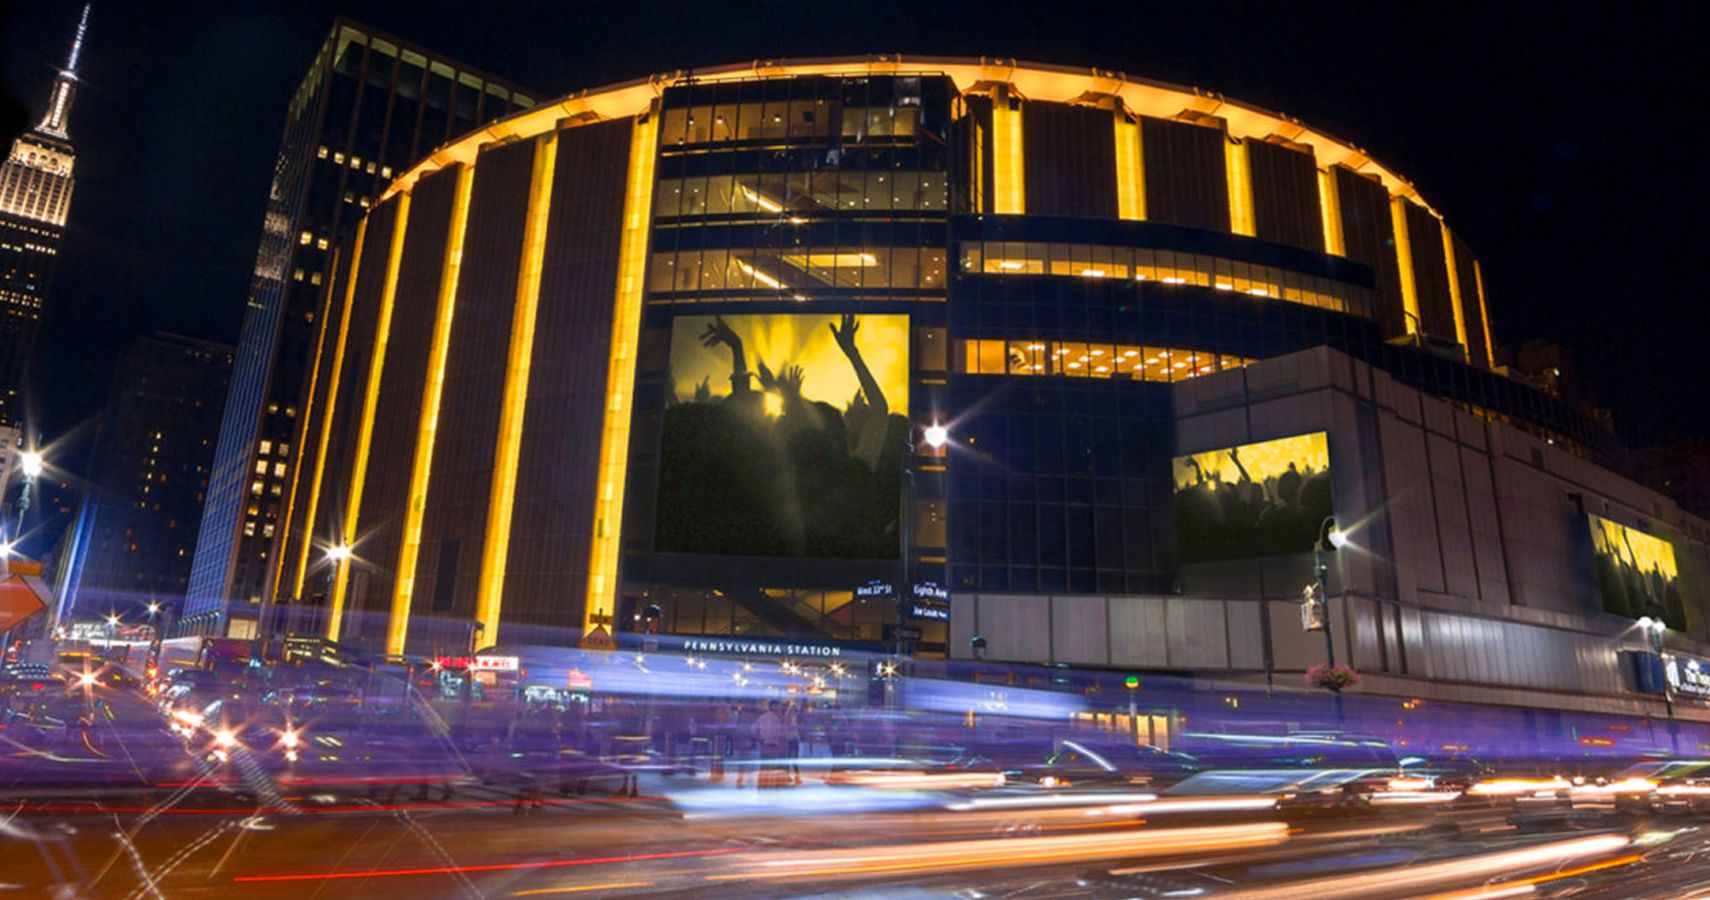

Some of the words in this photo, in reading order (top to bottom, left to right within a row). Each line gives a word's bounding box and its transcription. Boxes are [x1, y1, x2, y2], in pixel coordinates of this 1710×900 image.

[913, 584, 934, 597] Eighth
[935, 587, 947, 599] Ave
[684, 640, 782, 654] PENNSYLVANIA
[786, 644, 841, 656] STATION
